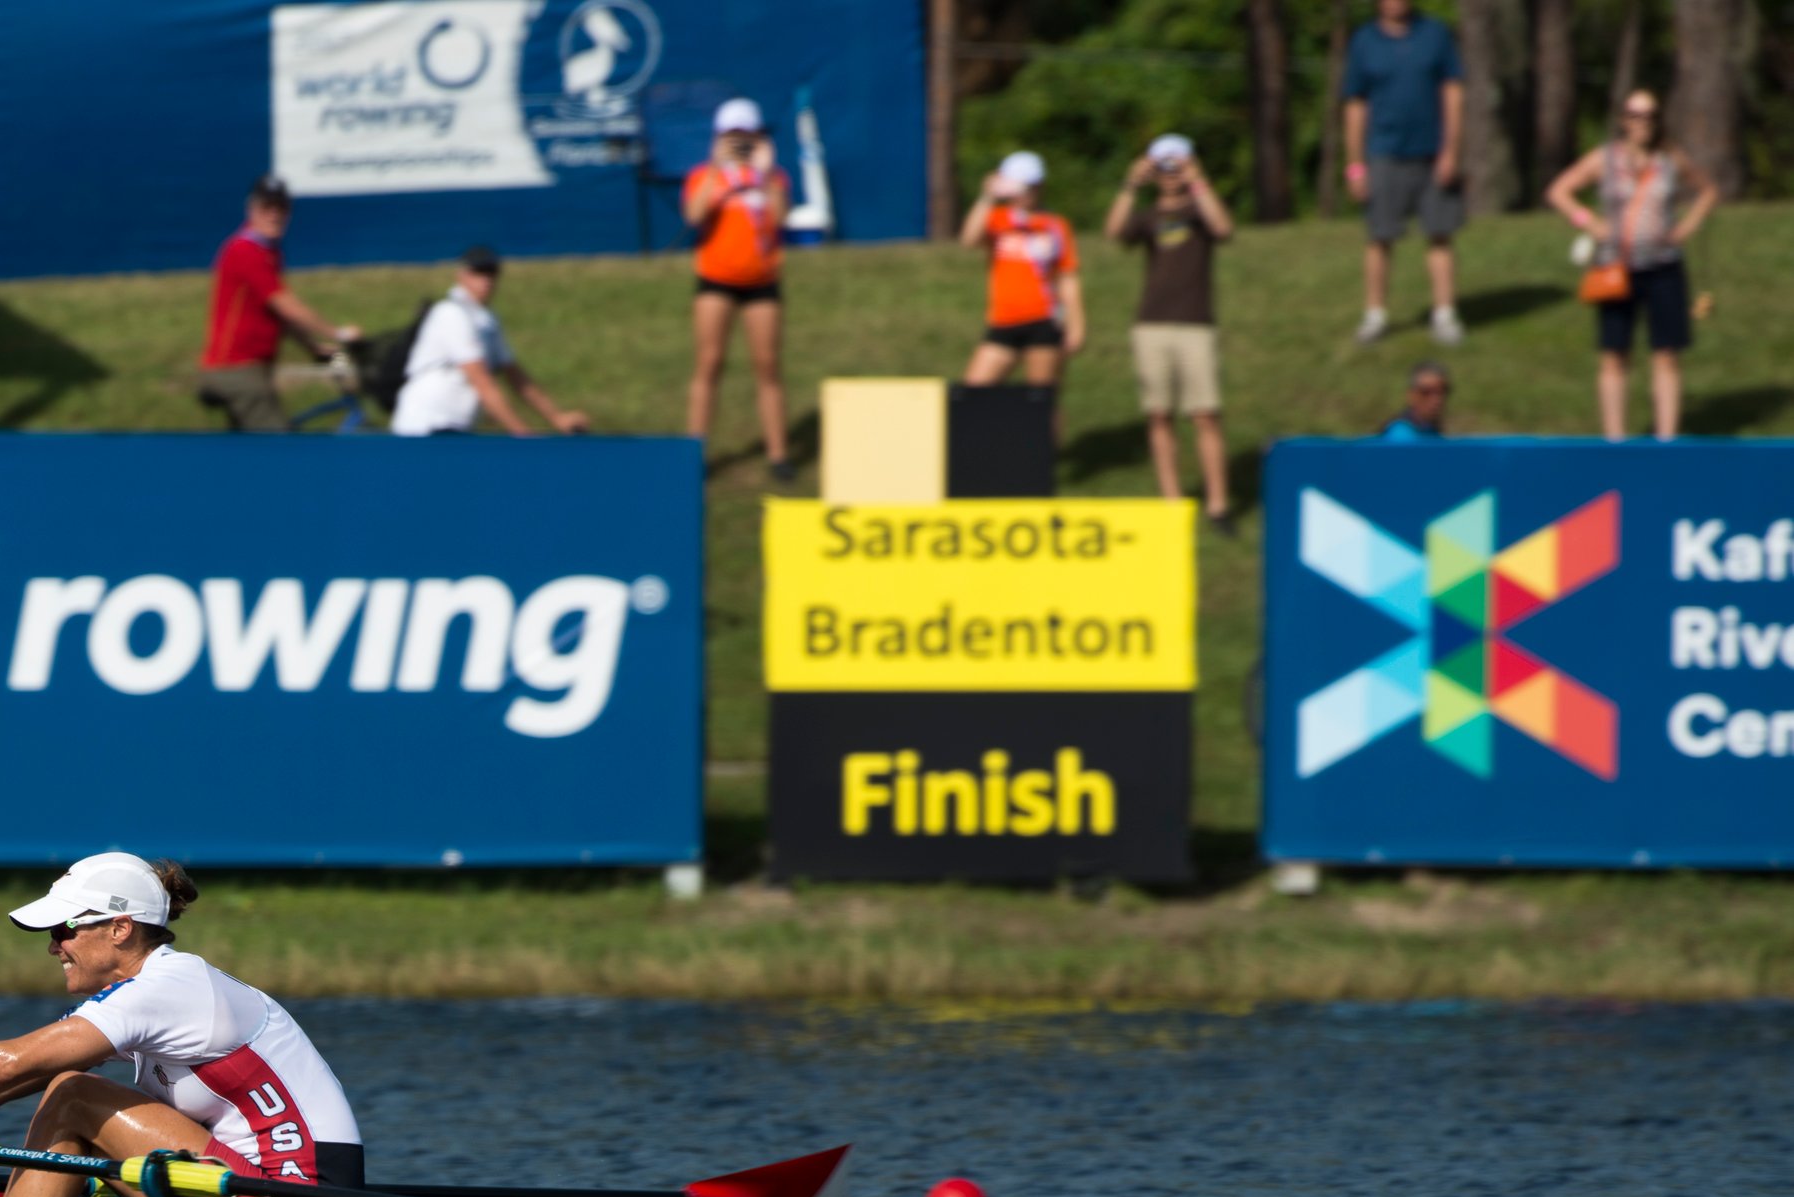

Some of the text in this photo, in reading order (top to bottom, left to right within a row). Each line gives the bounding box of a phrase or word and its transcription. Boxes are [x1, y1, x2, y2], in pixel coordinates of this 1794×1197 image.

[296, 62, 408, 98] world
[318, 101, 457, 137] rowing
[821, 508, 1138, 560] Sarasota-
[1671, 517, 1794, 583] Kaf
[803, 602, 1155, 659] Bradenton
[840, 747, 1118, 837] Finish
[247, 1082, 310, 1181] USA
[58, 1154, 108, 1167] SKINNY
